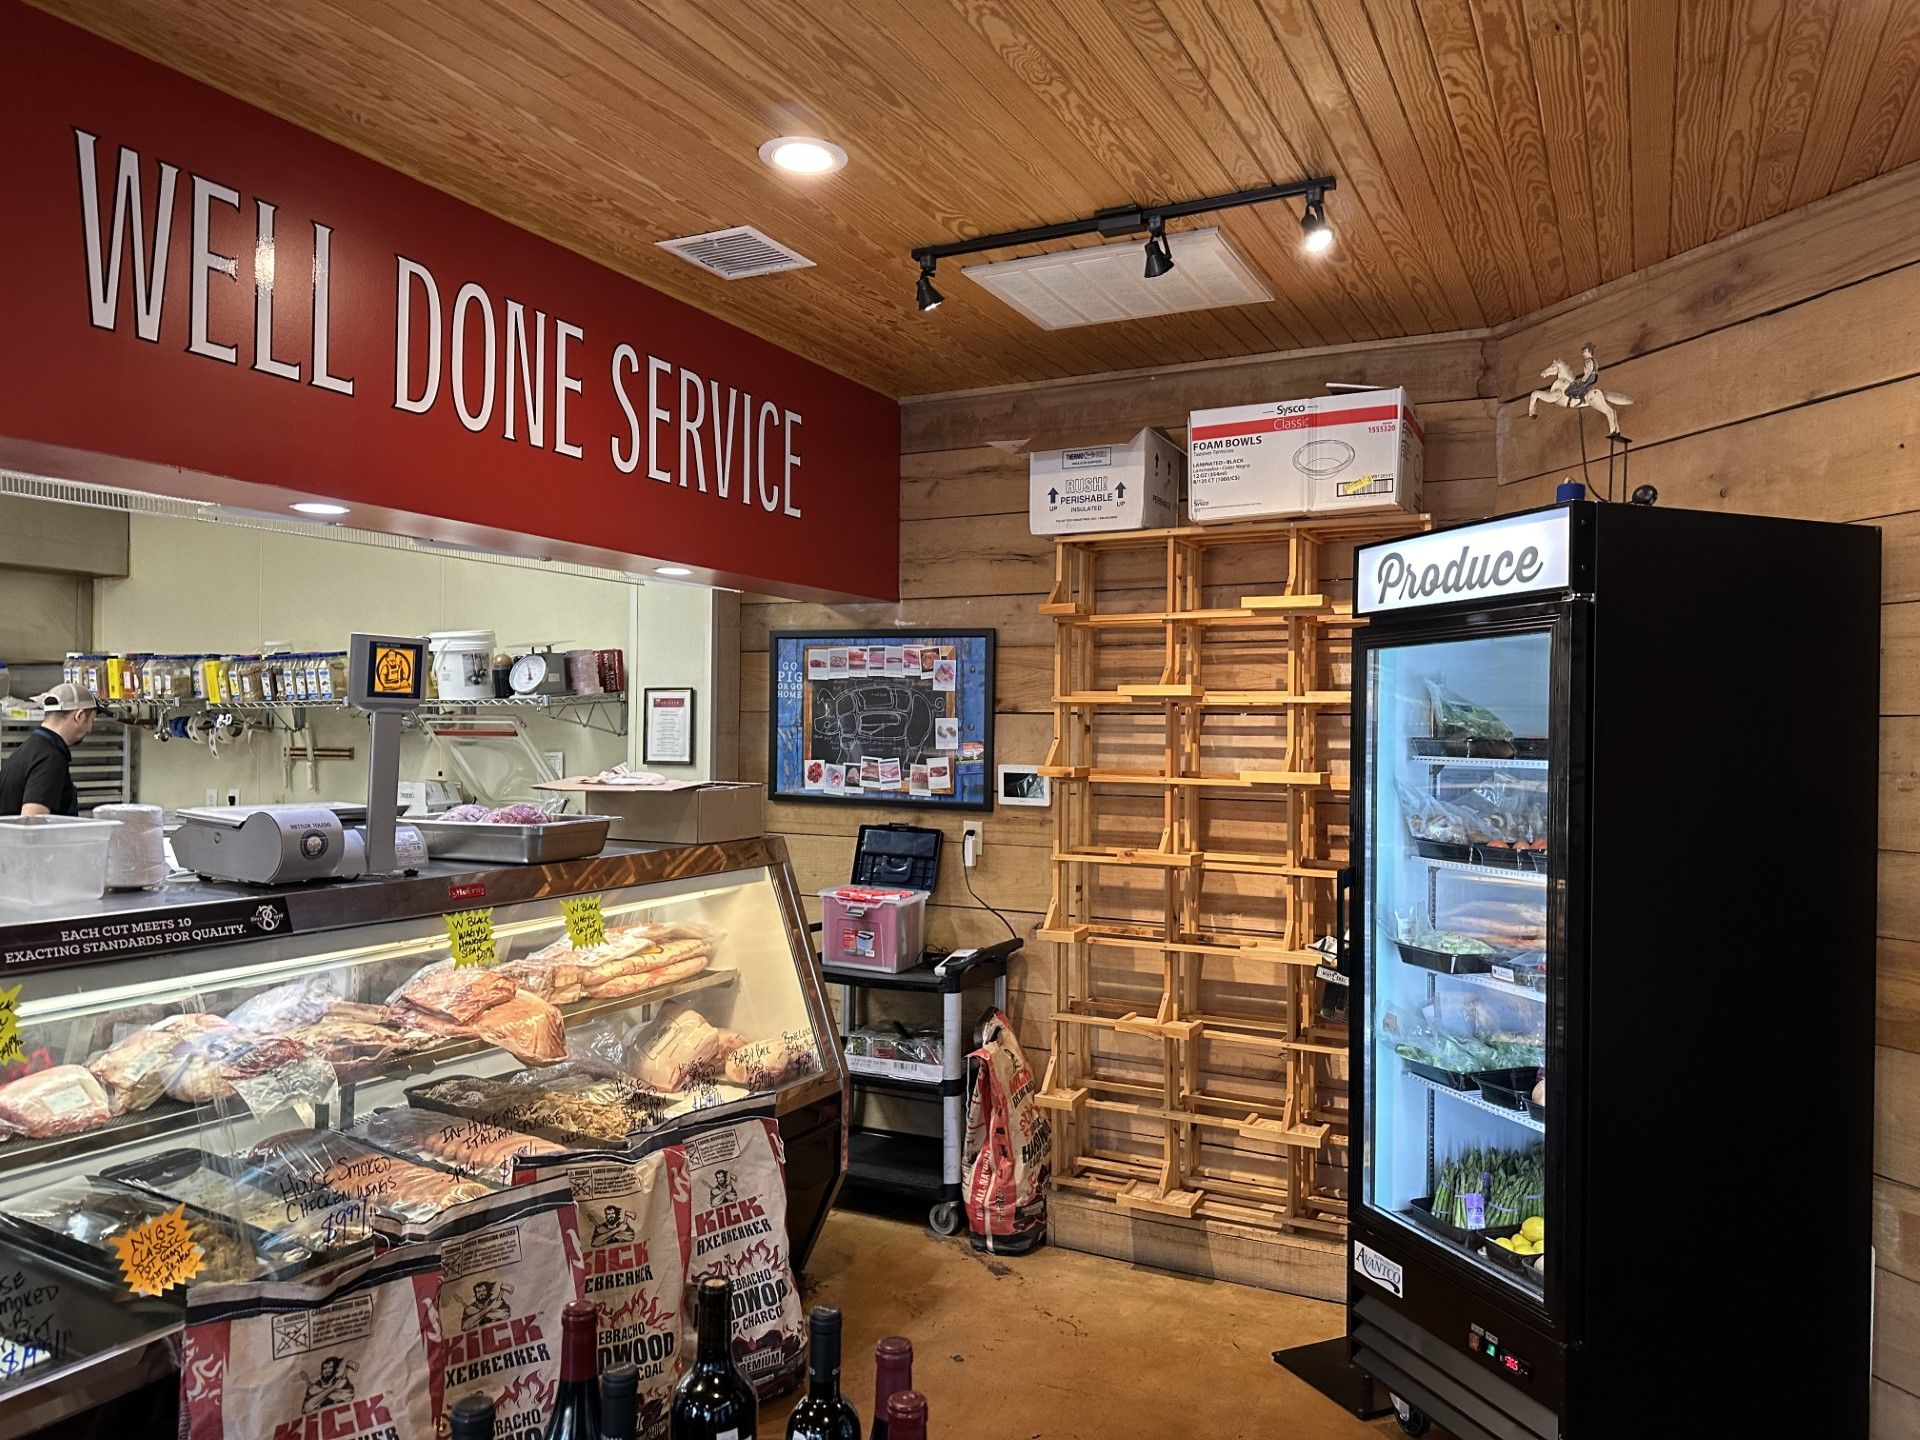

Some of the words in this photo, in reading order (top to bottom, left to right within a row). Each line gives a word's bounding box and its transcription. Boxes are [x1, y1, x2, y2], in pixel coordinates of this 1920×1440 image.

[72, 127, 355, 397] WELL
[392, 254, 585, 460] DONE
[610, 342, 804, 519] SERVICE
[1276, 405, 1306, 416] Sysco
[1273, 417, 1310, 431] Classic
[1192, 440, 1223, 452] FOAM
[1225, 435, 1263, 448] BOWLS
[1065, 476, 1108, 494] RUSH!
[1060, 492, 1113, 505] PERISHABLE
[1070, 504, 1102, 513] INSULATED
[1116, 500, 1126, 508] UP
[1377, 545, 1544, 605] Produce
[777, 670, 803, 683] PIG
[782, 661, 798, 671] GO
[777, 690, 803, 699] HOME
[790, 682, 803, 691] GO
[60, 927, 100, 942] EACH
[102, 923, 129, 937] CUT
[131, 919, 175, 934] MEETS
[177, 917, 192, 928] 10
[465, 915, 490, 928] BLACK
[4, 944, 81, 964] EXACTING
[82, 934, 164, 954] STANDARDS
[164, 931, 190, 944] FOR
[191, 924, 247, 941] QUALITY.
[502, 1102, 540, 1125] MADE
[280, 1166, 335, 1204] HOUSE
[337, 1156, 392, 1181] SMOKED
[286, 1188, 352, 1223] CHICKEN
[357, 1176, 397, 1199] WINGS
[696, 1217, 773, 1257] AXEBREAKER
[131, 1234, 186, 1268] CLASSIC
[1355, 1246, 1401, 1285] AVANTCO
[584, 1264, 654, 1294] EBREAKER
[732, 1267, 772, 1293] EBRACHO
[0, 1285, 59, 1315] MOKED
[743, 1304, 785, 1331] CHARCO
[598, 1321, 646, 1346] EBRACHO
[445, 1342, 551, 1389] XEBREAKER
[596, 1331, 675, 1376] DWOOD
[637, 1360, 665, 1382] COAL
[495, 1408, 541, 1436] RACHO
